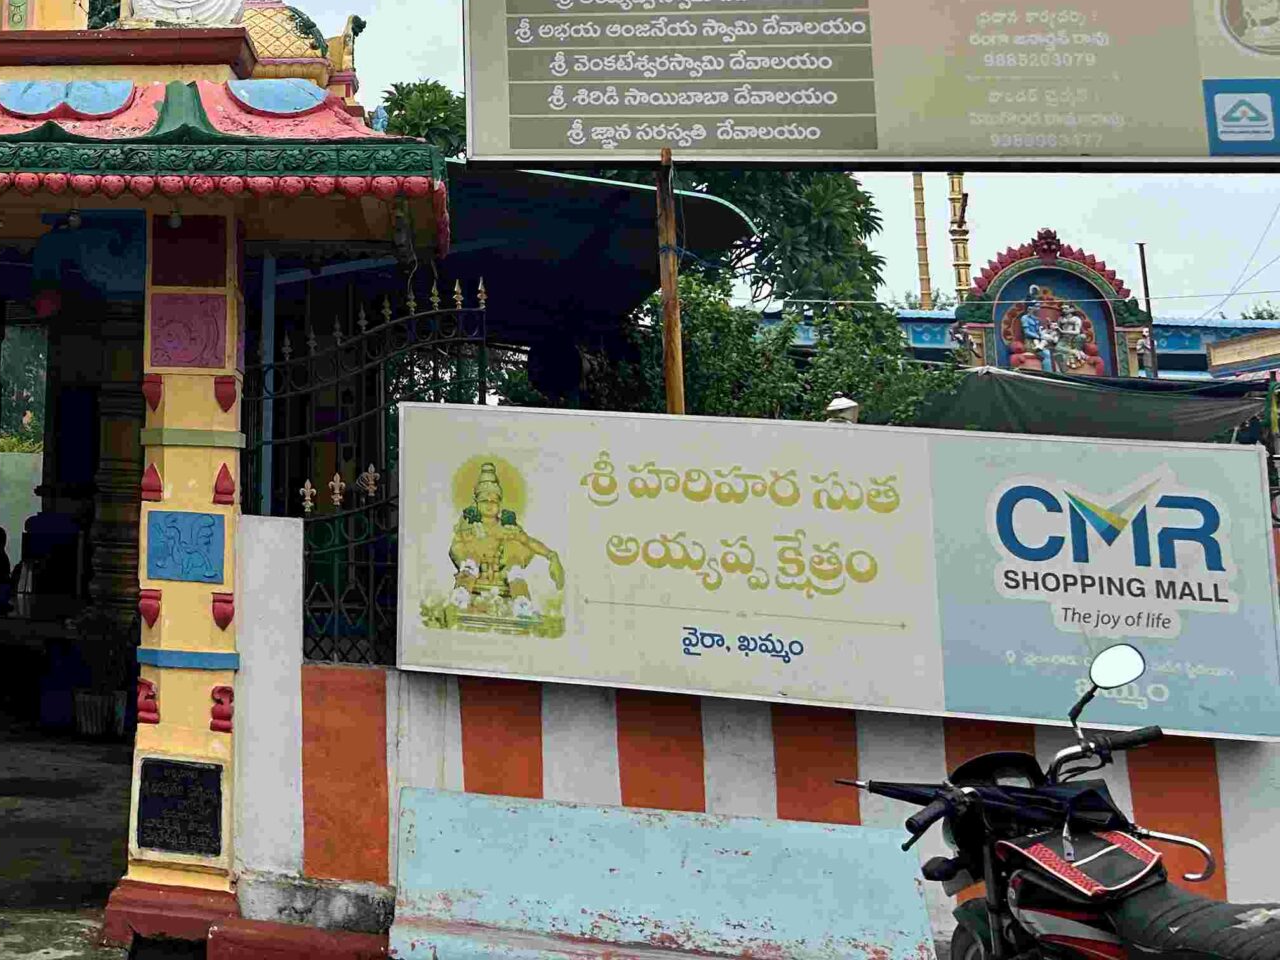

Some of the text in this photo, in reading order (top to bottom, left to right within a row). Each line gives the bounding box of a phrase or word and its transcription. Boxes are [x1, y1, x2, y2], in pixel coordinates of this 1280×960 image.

[514, 16, 533, 44] శ్రీ
[538, 20, 601, 42] అభయ
[702, 18, 758, 43] స్వామి
[762, 14, 866, 36] దేవాలయం
[549, 48, 833, 78] శ్రీ వెంకటేశ్వరస్వామి దేవాలయం
[547, 83, 838, 111] శ్రీ శిరిడి సాయిబాబా దేవాలయం
[567, 118, 586, 146] శ్రీ
[636, 123, 707, 147] సరస్వతి
[717, 118, 822, 141] దేవాలయం
[581, 450, 901, 515] శ్రీ హరిహర సుత
[996, 477, 1227, 572] CMR
[605, 528, 879, 600] అయ్యప్ప క్షేత్రం
[1003, 569, 1230, 604] SHOPPING MALL
[1061, 607, 1171, 630] The joy of life
[682, 626, 806, 664] వైరా, ఖమ్మం
